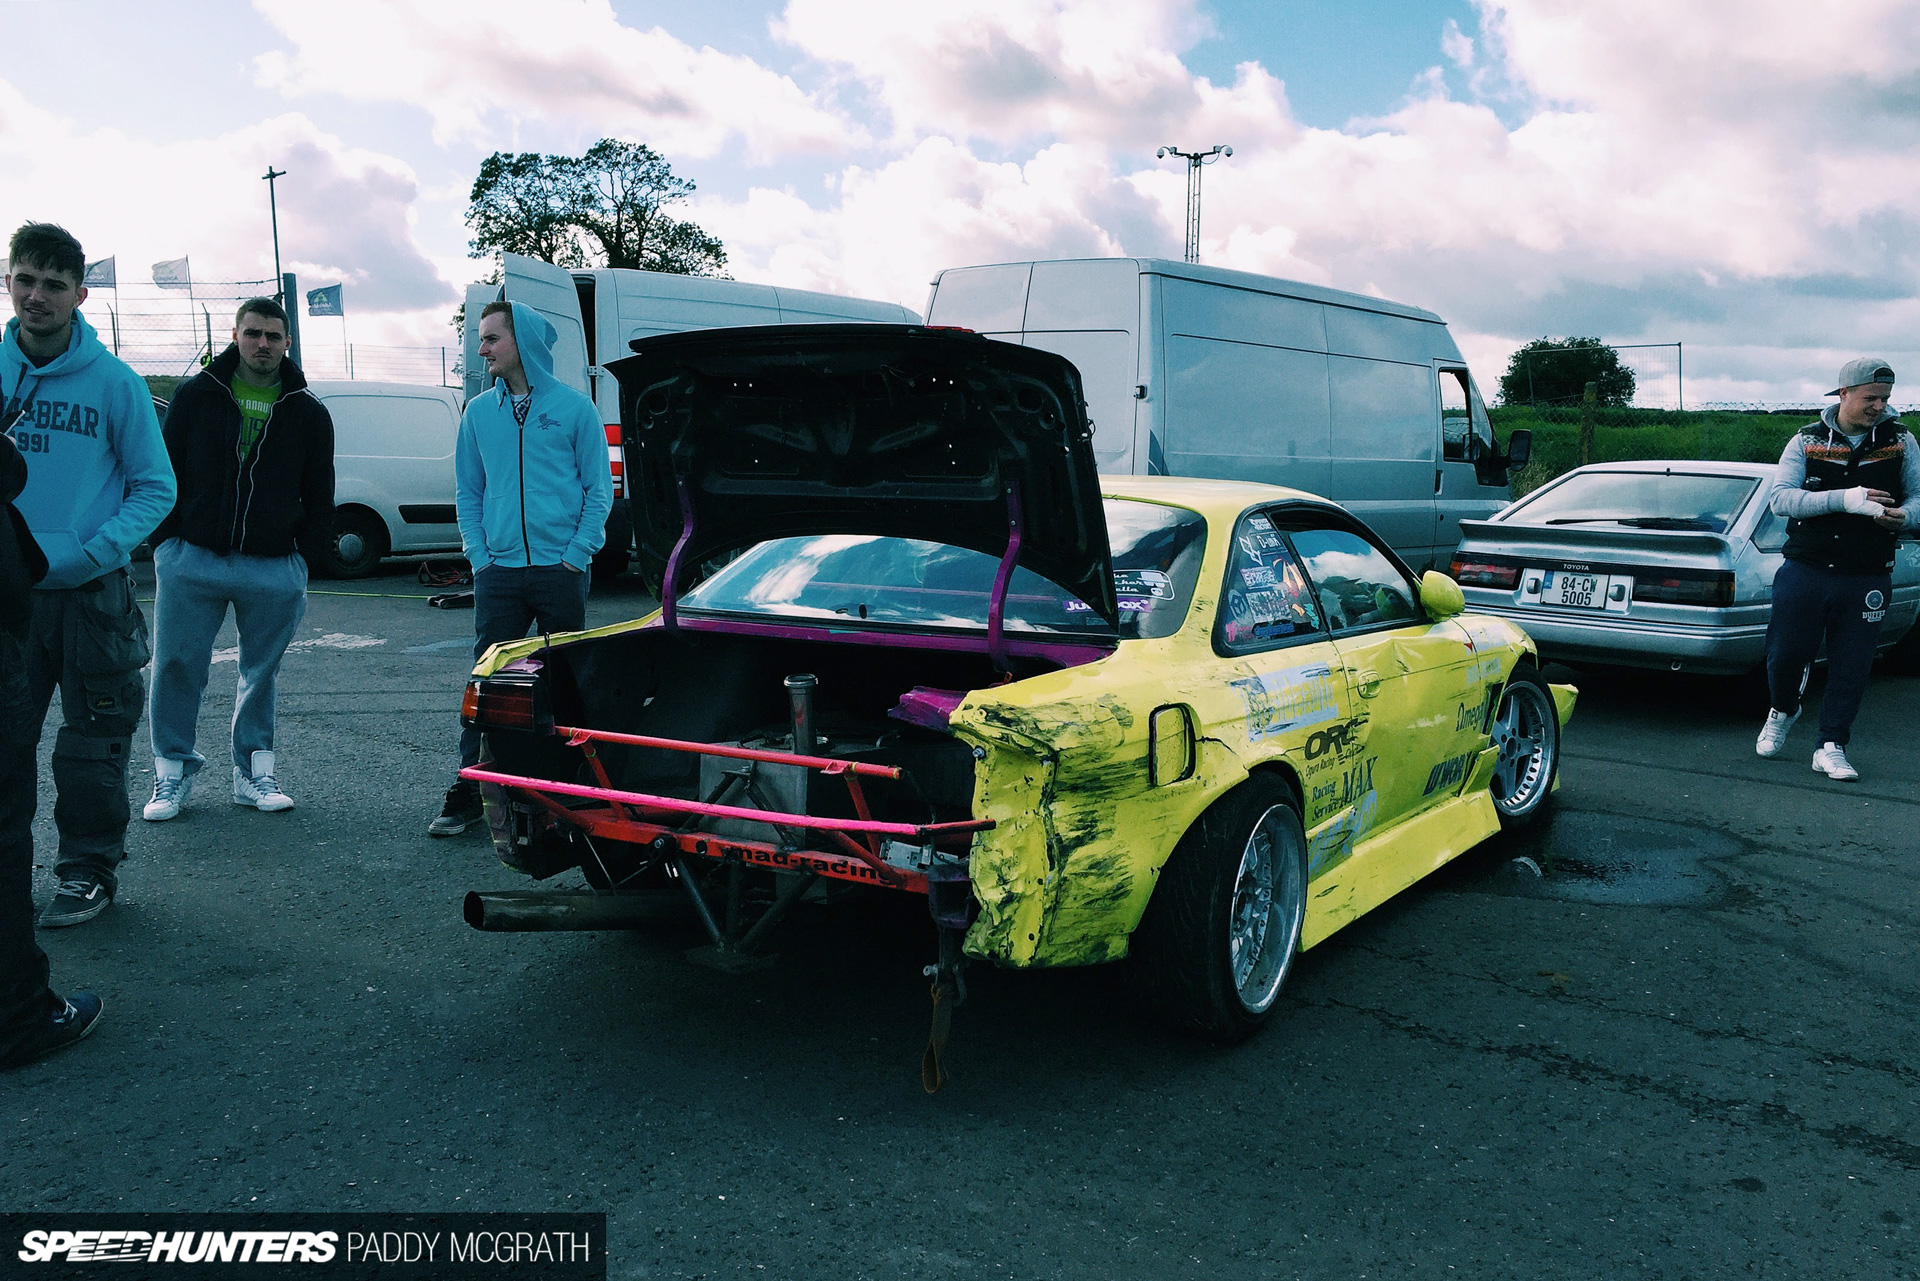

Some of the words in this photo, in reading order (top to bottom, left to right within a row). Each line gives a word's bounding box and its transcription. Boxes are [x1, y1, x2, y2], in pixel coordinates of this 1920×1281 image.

[1563, 563, 1590, 571] TOYOTA
[1561, 576, 1598, 593] 84-CW
[1561, 590, 1592, 606] 5005
[1340, 755, 1378, 804] MAX
[1311, 779, 1337, 802] Racing
